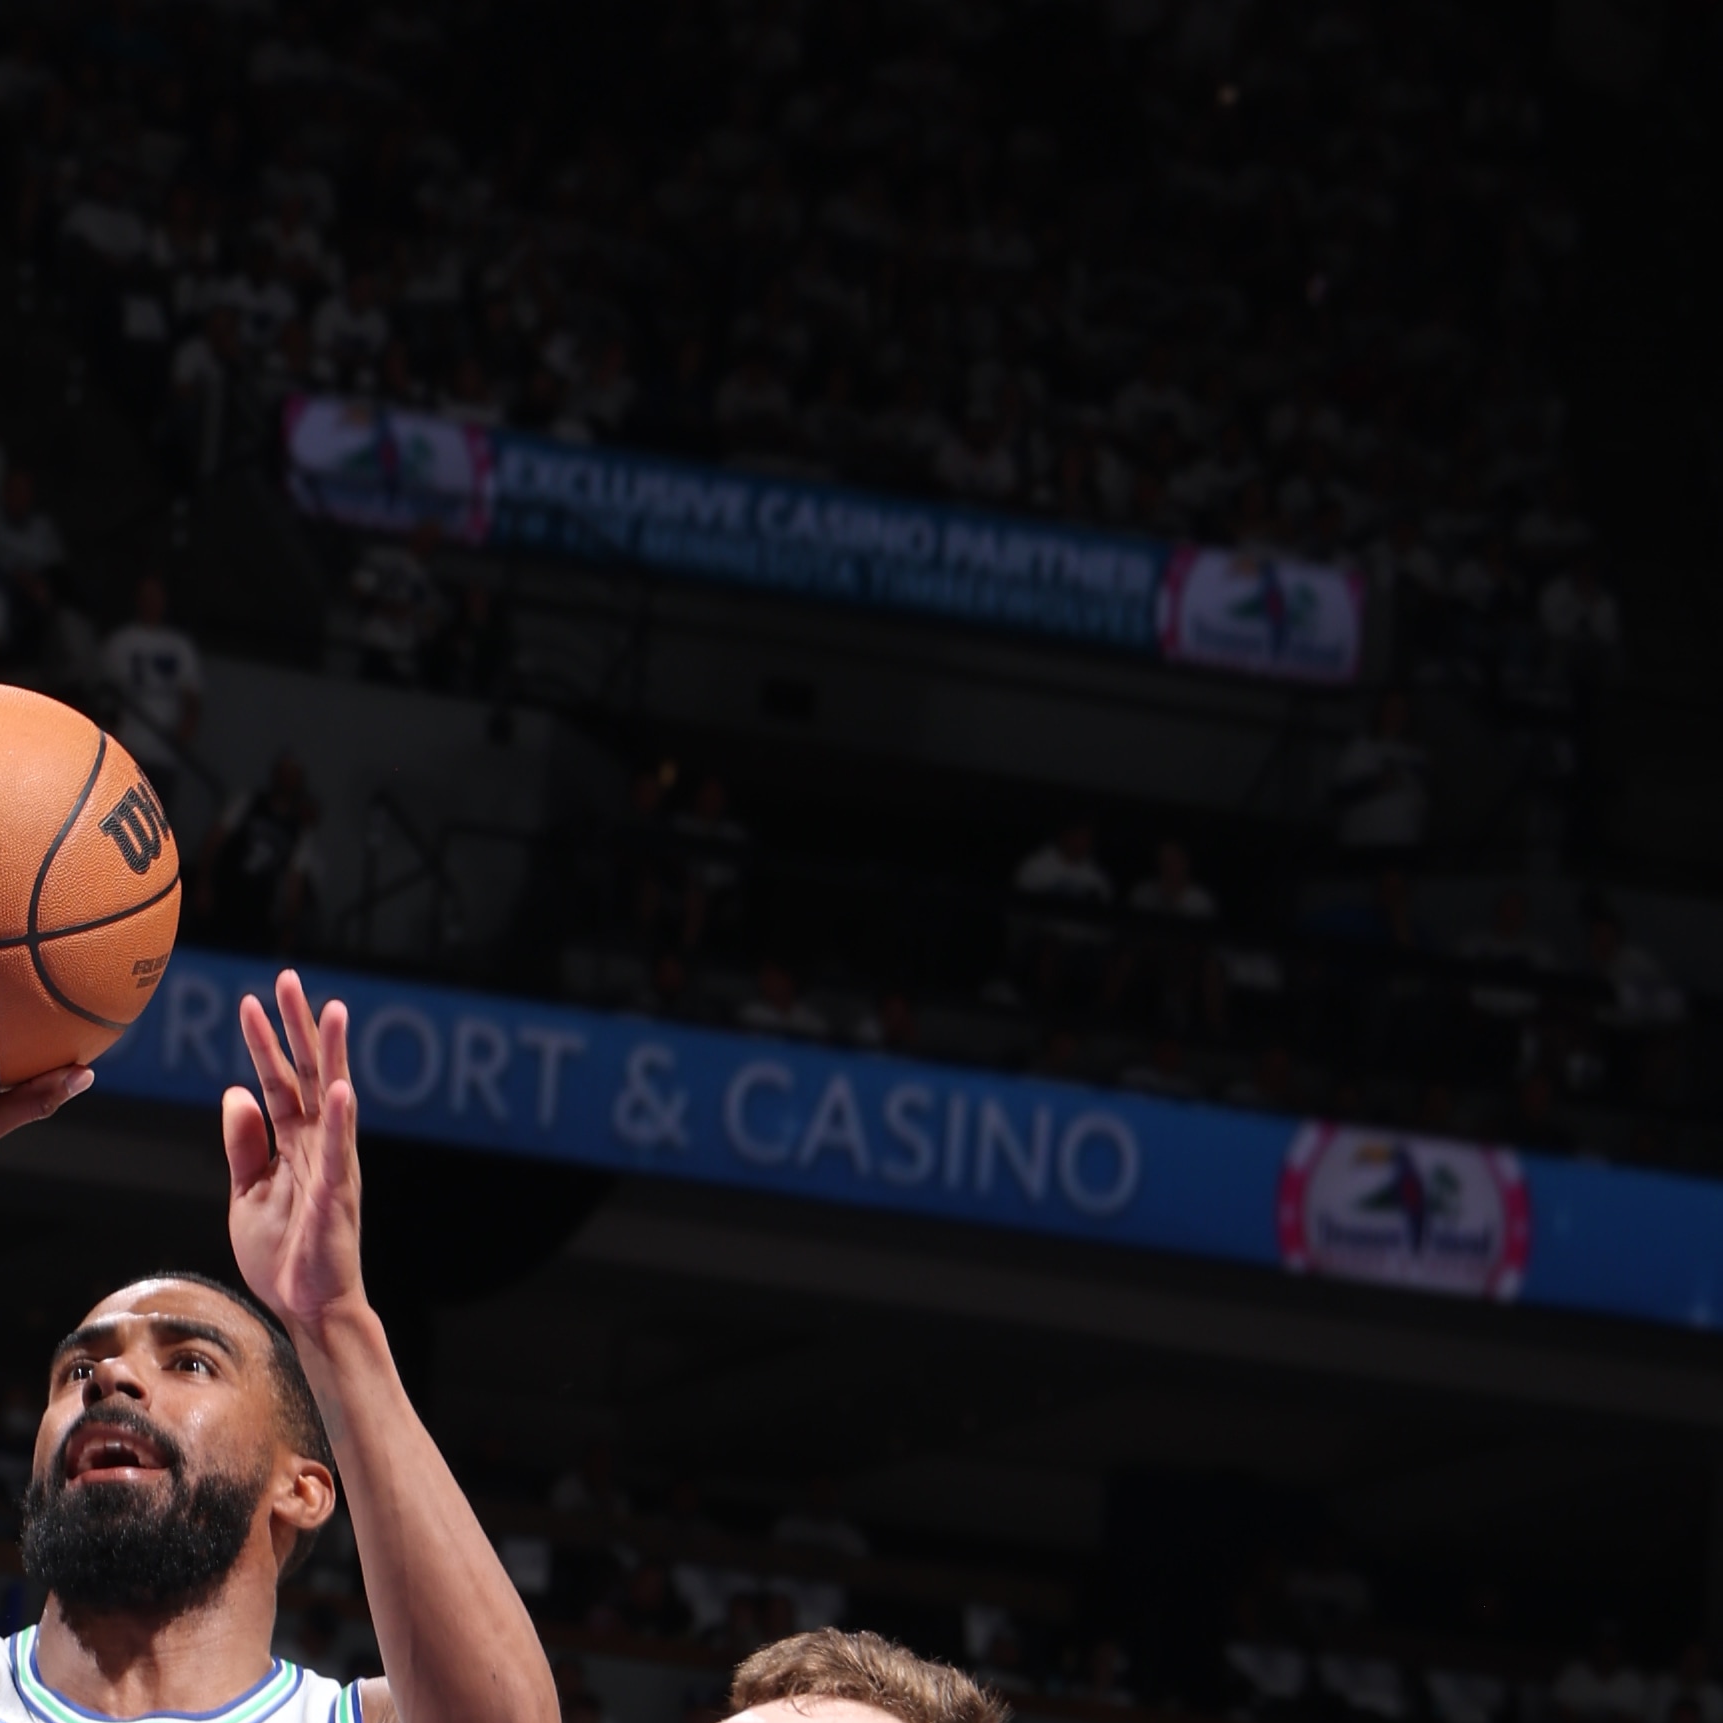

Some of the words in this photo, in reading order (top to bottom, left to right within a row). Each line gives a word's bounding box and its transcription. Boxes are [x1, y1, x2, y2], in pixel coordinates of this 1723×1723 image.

[756, 486, 937, 565] CASINO
[942, 518, 1155, 600] PARTNER
[160, 967, 586, 1130] RORT
[611, 1042, 692, 1150] &
[721, 1057, 1141, 1220] CASINO
